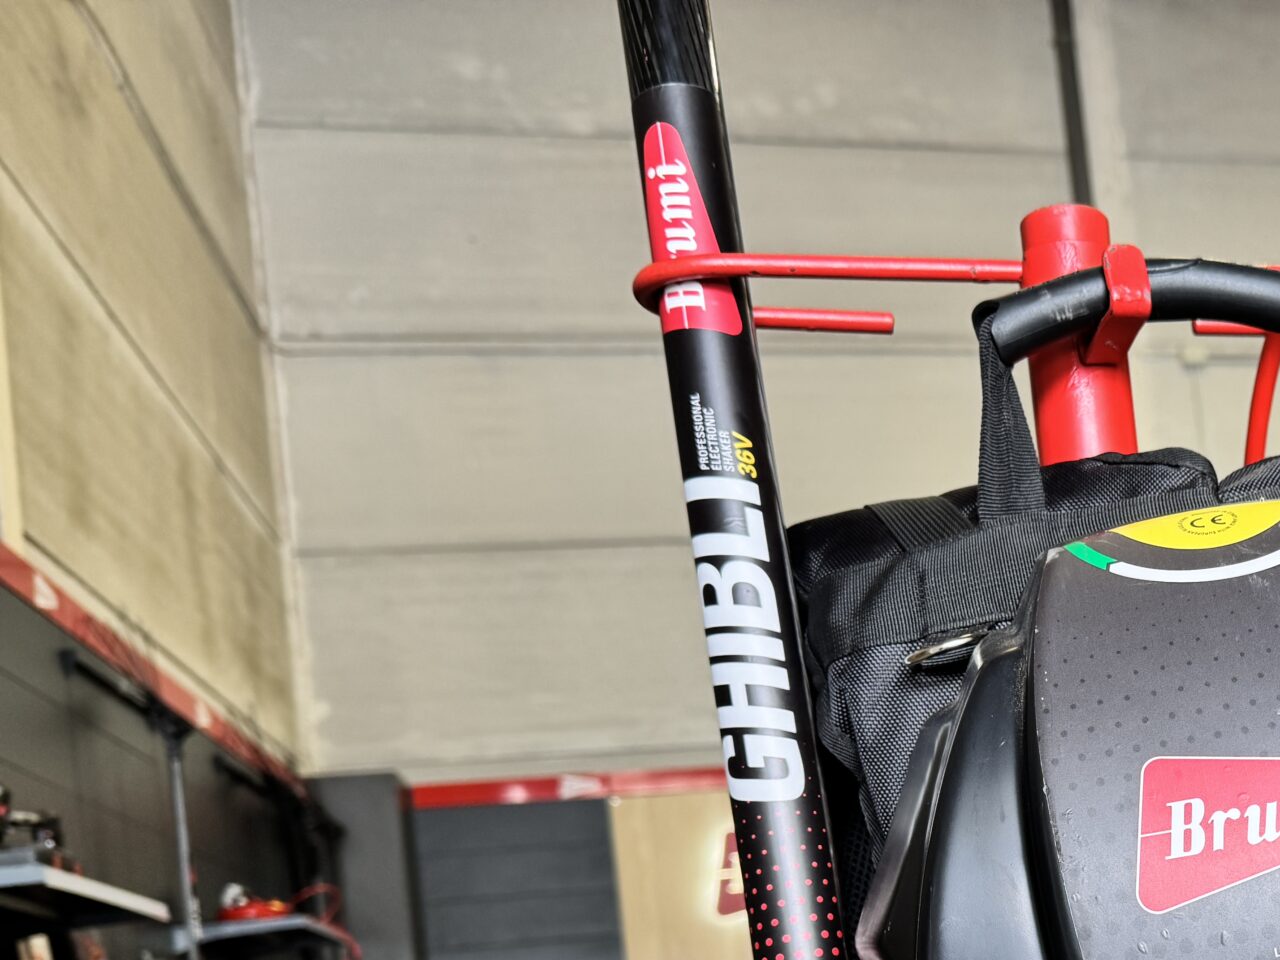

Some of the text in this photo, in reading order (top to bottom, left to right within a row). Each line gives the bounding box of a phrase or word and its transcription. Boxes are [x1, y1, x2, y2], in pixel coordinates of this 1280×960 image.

[646, 158, 707, 312] Bumi
[690, 392, 710, 471] PROFESSIONAL
[703, 407, 722, 471] ELECTRONIC
[719, 430, 736, 472] SHAKER
[731, 431, 758, 478] 36V
[683, 476, 805, 802] GHIBLI
